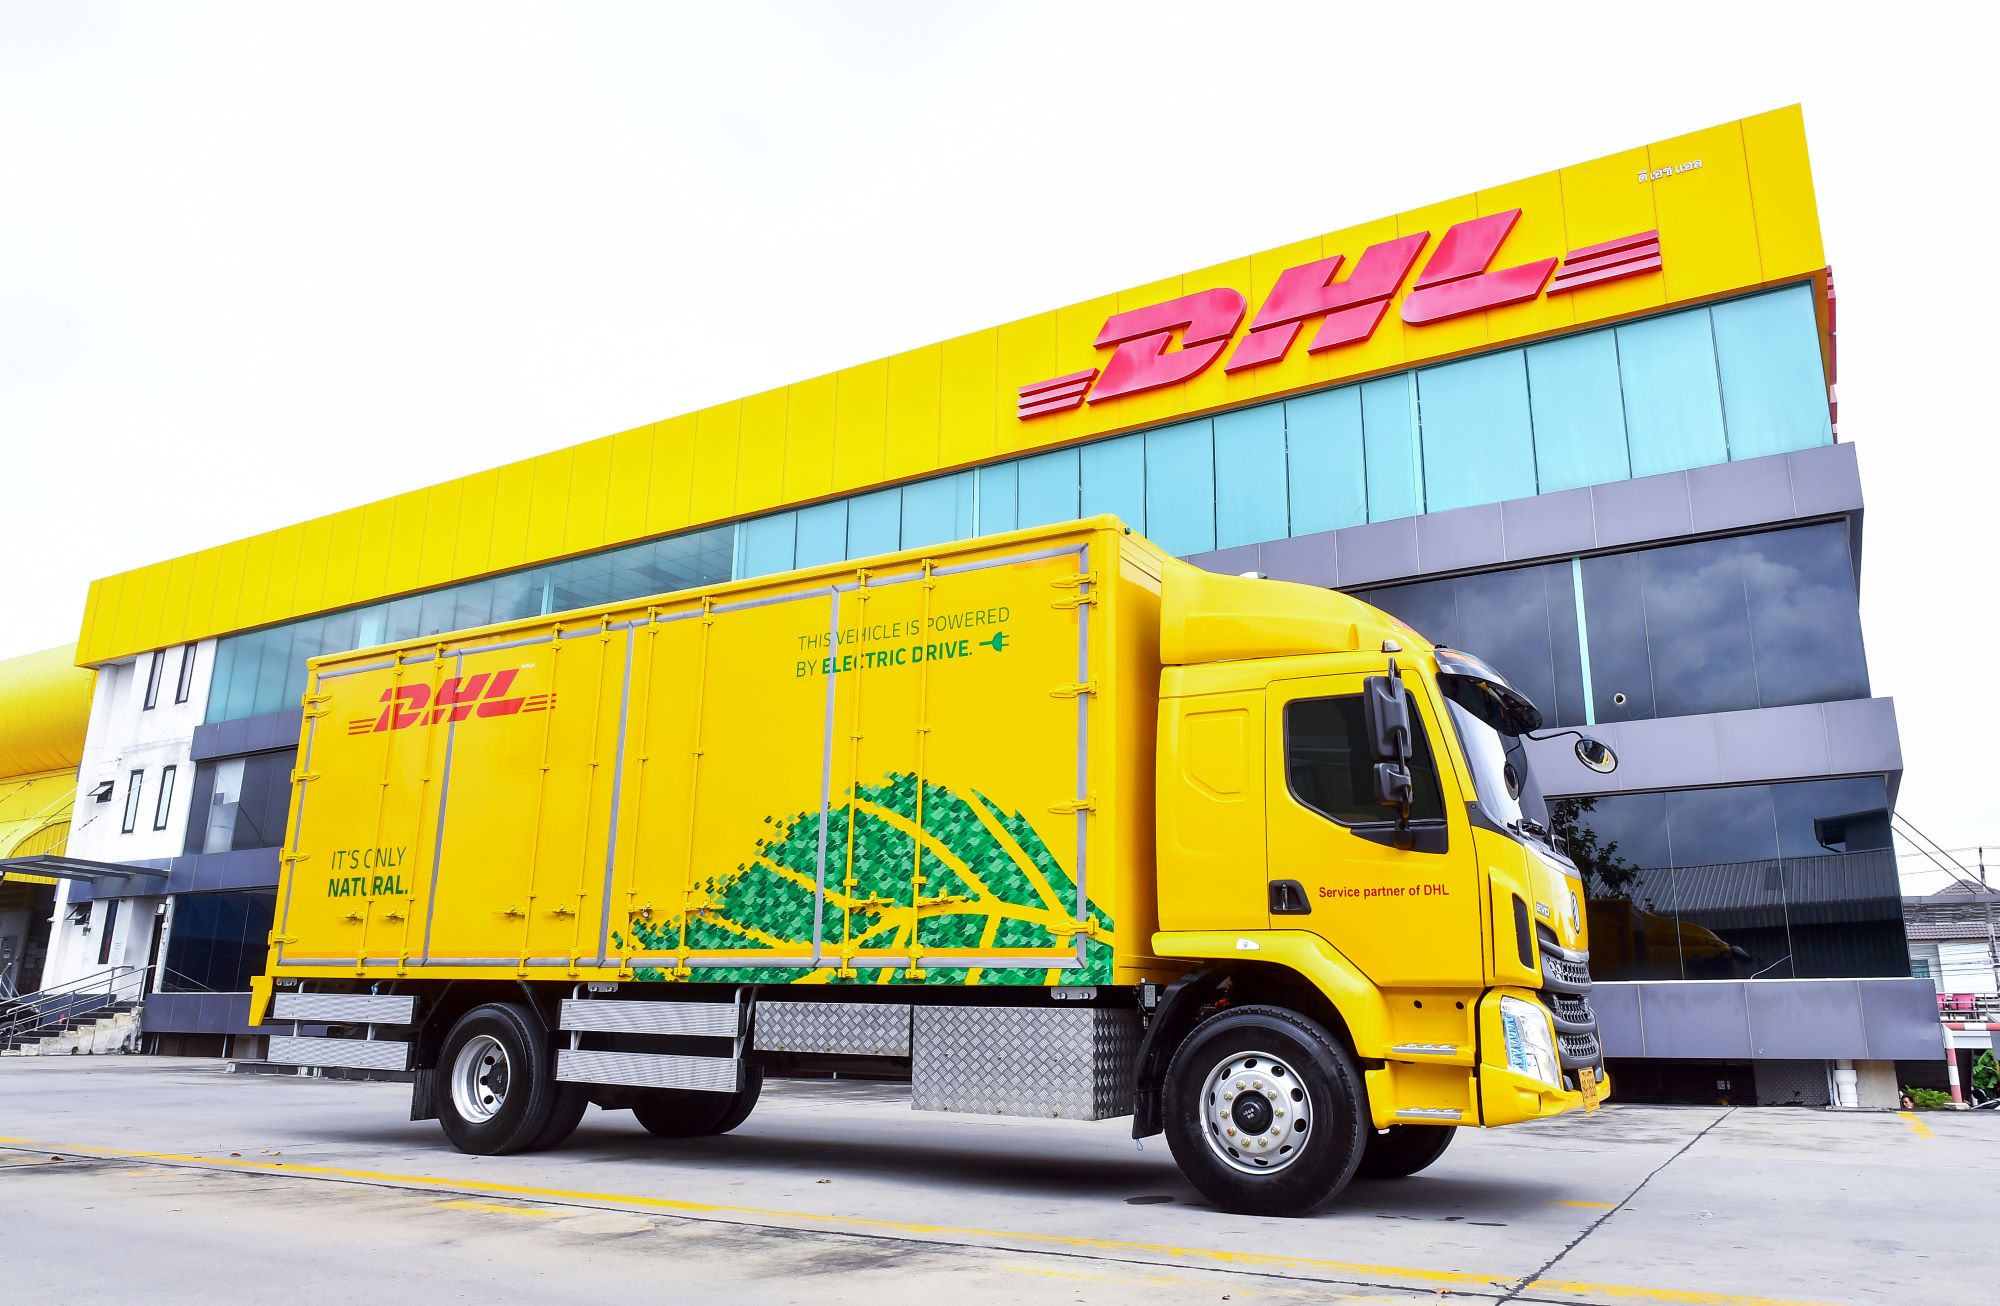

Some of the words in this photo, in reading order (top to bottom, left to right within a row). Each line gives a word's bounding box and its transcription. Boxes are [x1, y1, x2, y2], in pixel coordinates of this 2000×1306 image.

[1086, 207, 1558, 405] DHL
[797, 632, 832, 651] THIS
[835, 622, 901, 645] VEHICLE
[906, 619, 920, 636] IS
[796, 659, 818, 678] BY
[372, 668, 527, 733] DHL
[331, 849, 360, 870] IT'S
[1318, 886, 1360, 898] Service
[1363, 886, 1405, 900] partner
[1408, 884, 1421, 896] of
[1423, 883, 1450, 896] DHL
